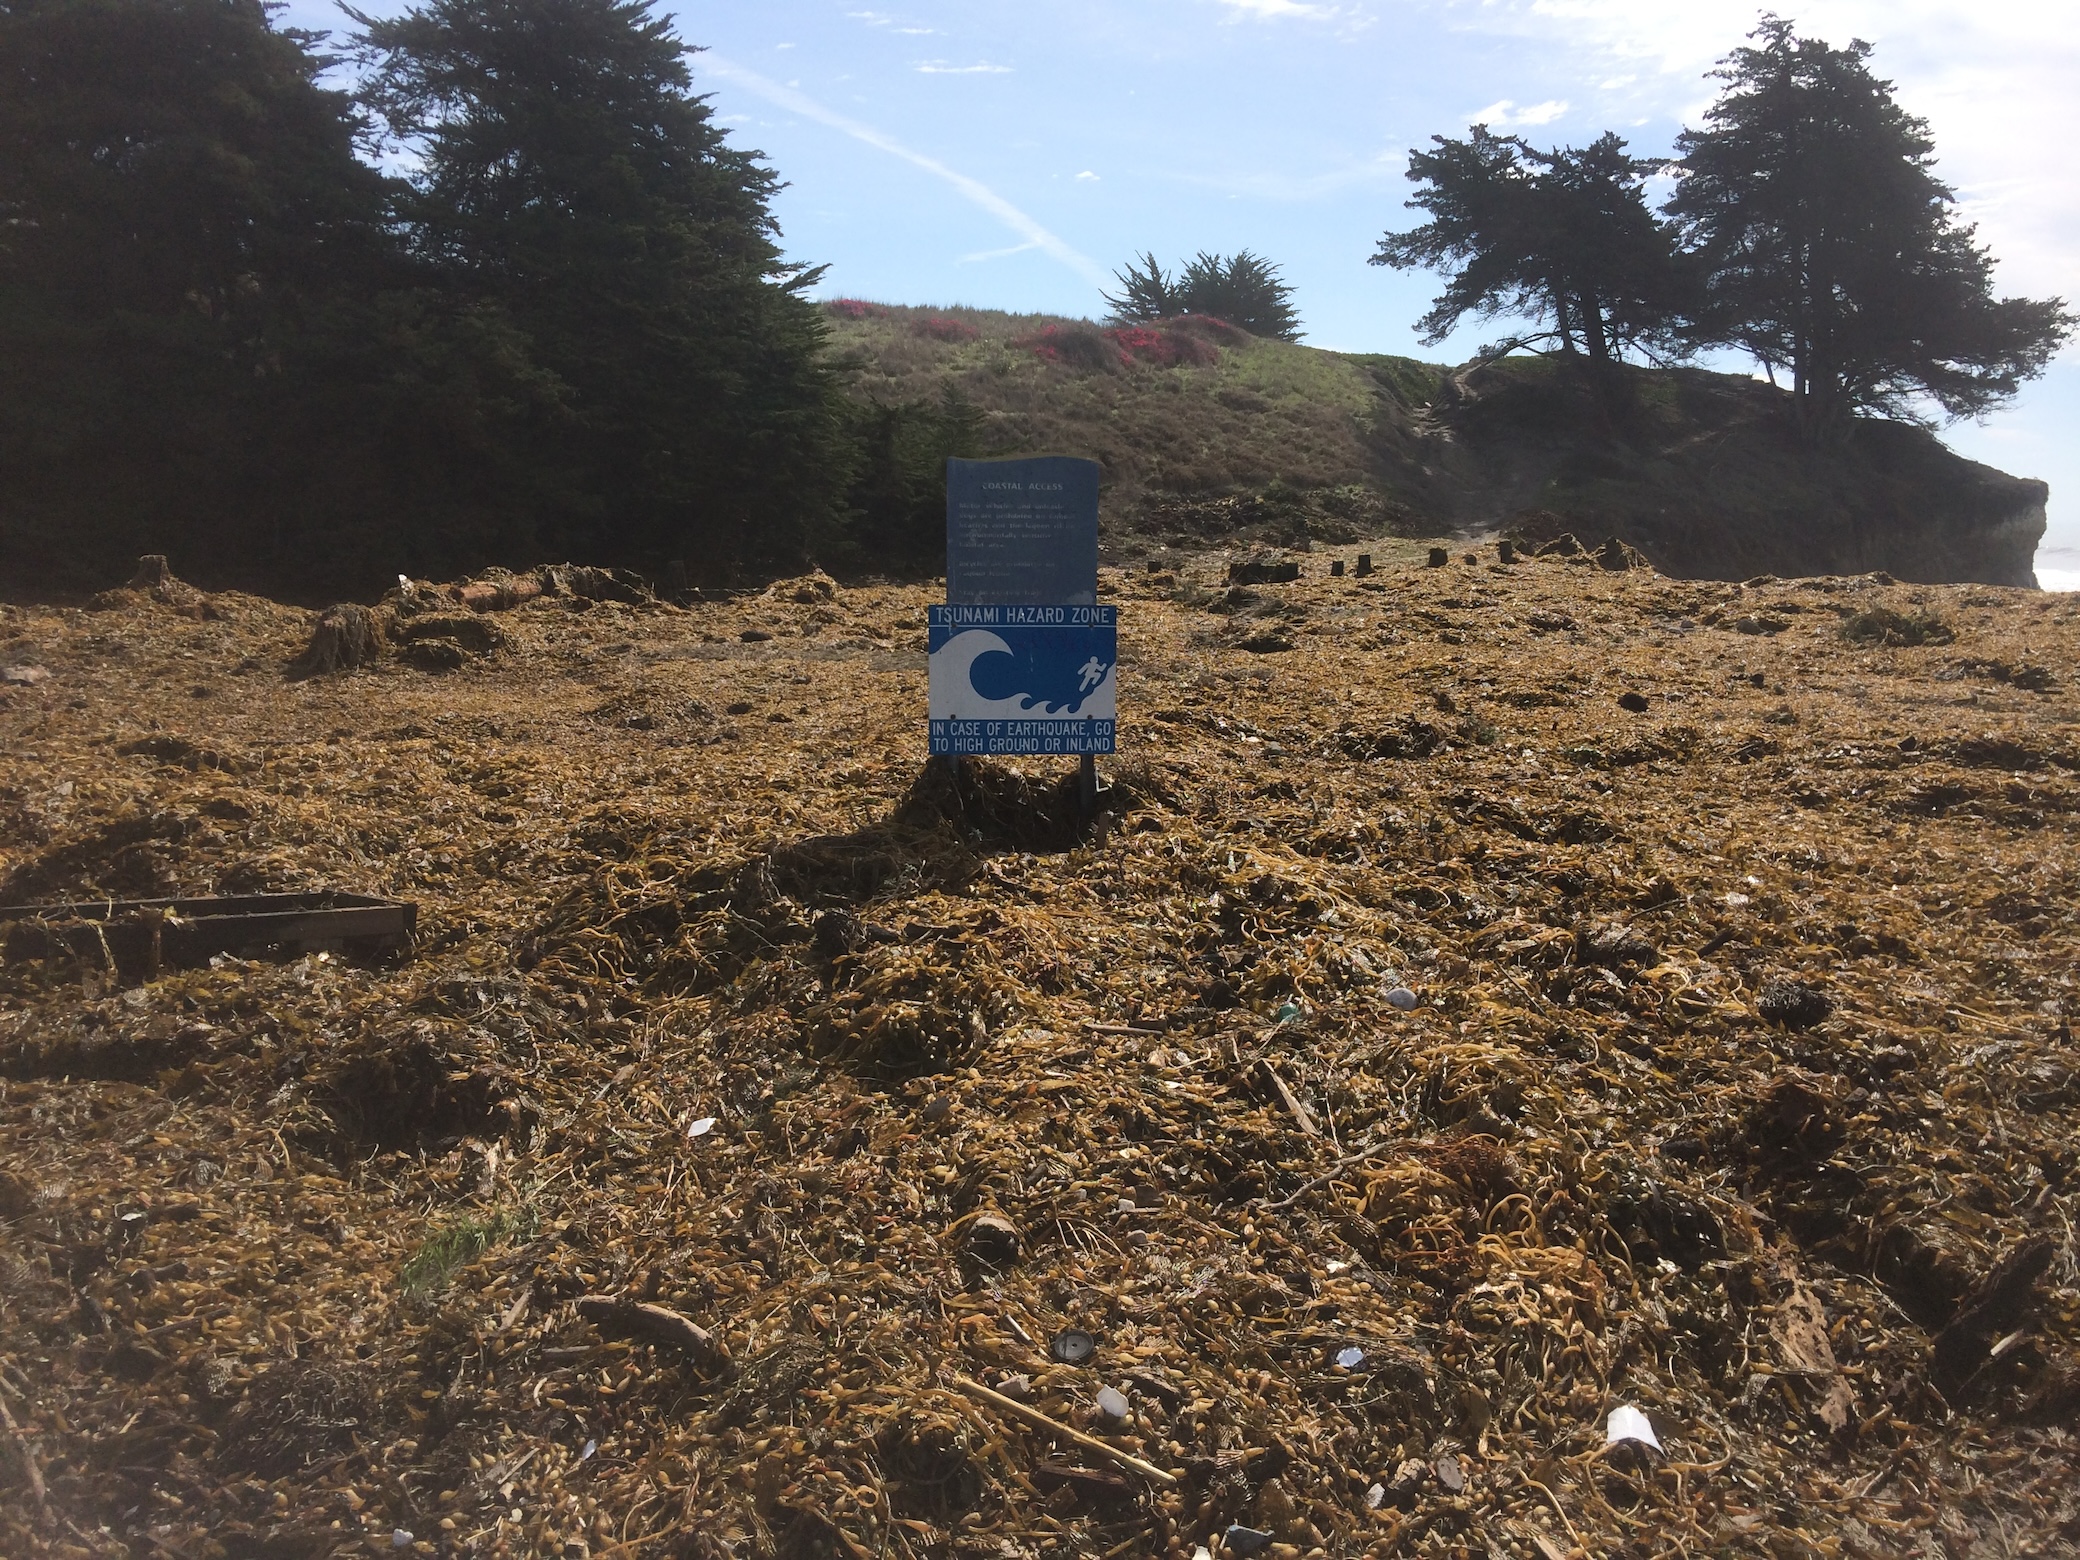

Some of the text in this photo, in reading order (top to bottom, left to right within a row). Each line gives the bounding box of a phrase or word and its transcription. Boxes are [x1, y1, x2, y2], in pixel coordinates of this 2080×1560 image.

[1028, 482, 1063, 491] ACCESS
[936, 607, 1110, 623] TSUNAMI HAZARD ZONE
[932, 722, 1111, 737] IN CASE OF EARTHQUAKE, GO
[934, 737, 1111, 751] TO HIGH GROUND OR INLAND
